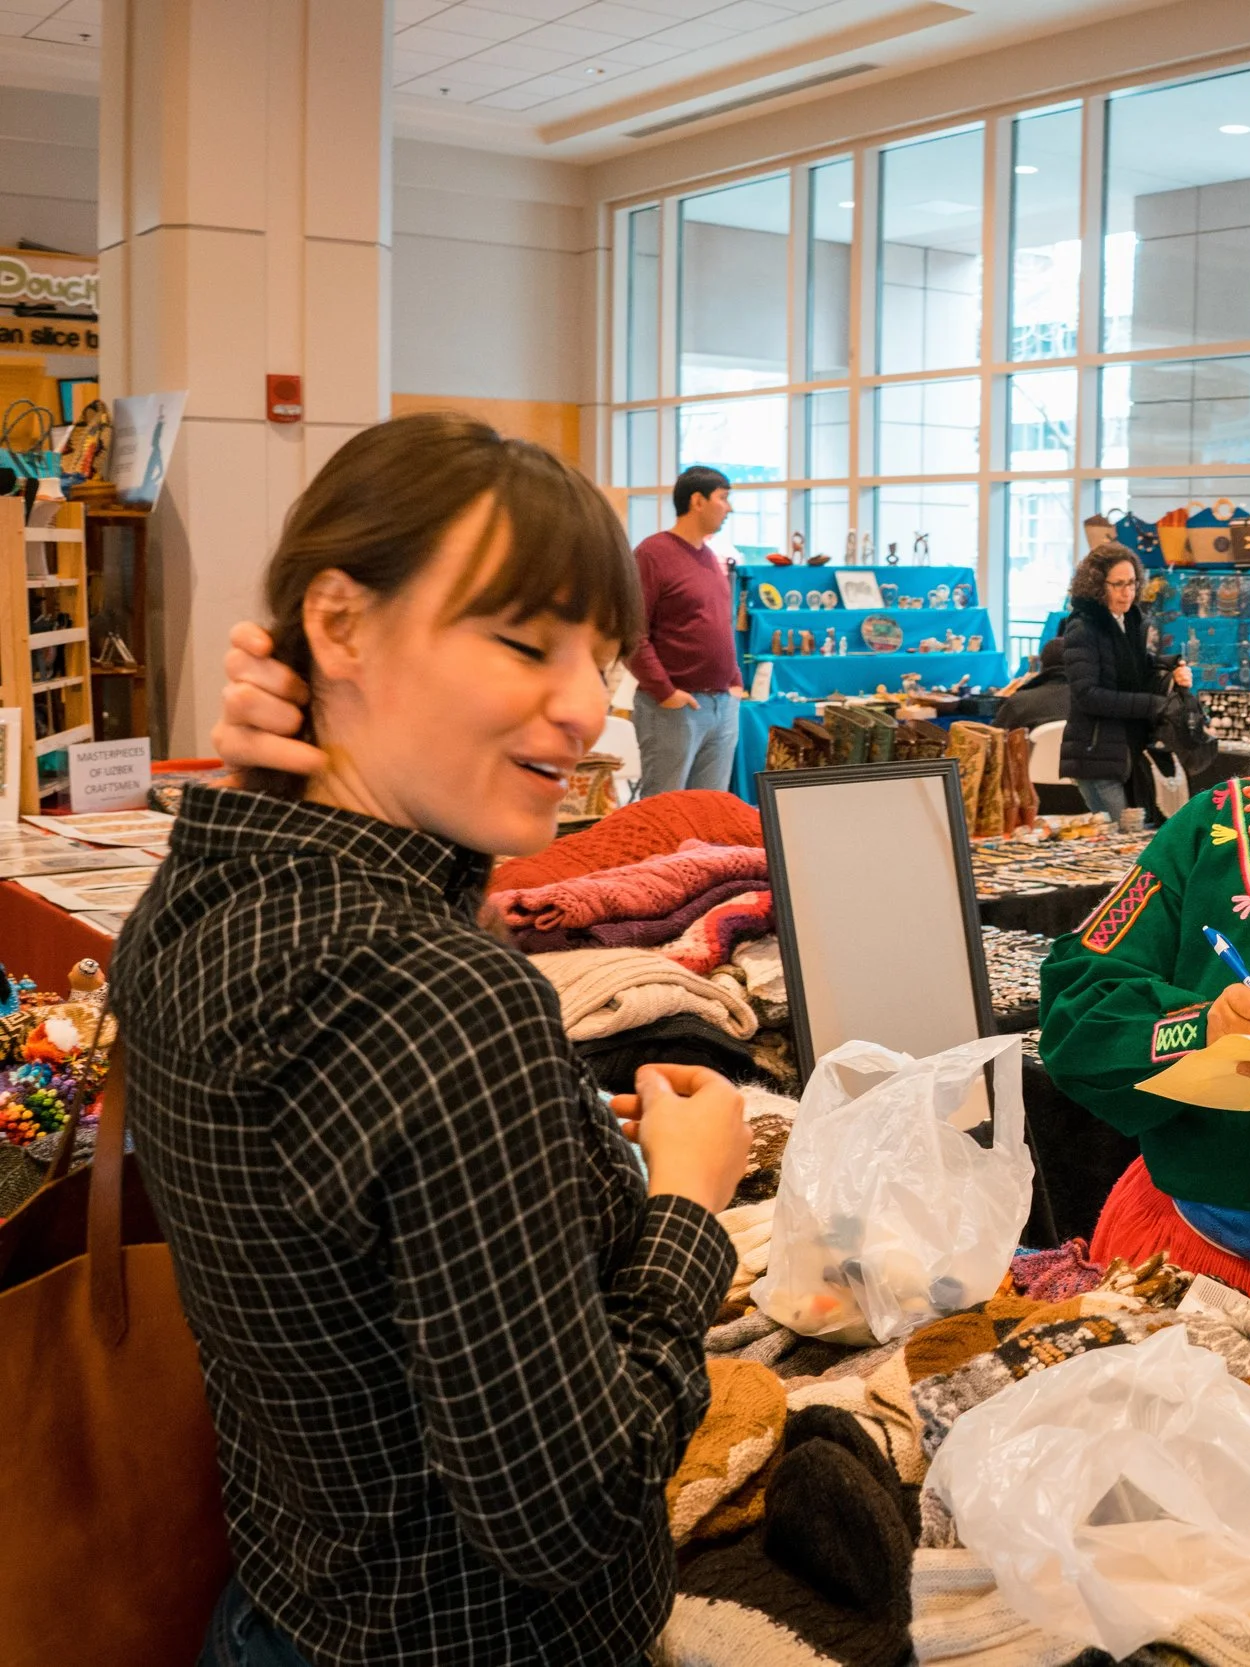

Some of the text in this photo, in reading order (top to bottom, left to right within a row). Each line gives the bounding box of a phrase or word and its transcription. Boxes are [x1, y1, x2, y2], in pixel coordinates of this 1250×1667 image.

[31, 326, 81, 347] slice
[76, 747, 145, 762] MASTERPIECES
[89, 764, 134, 778] OF UZBEK
[84, 780, 140, 795] CRAFTSMEN
